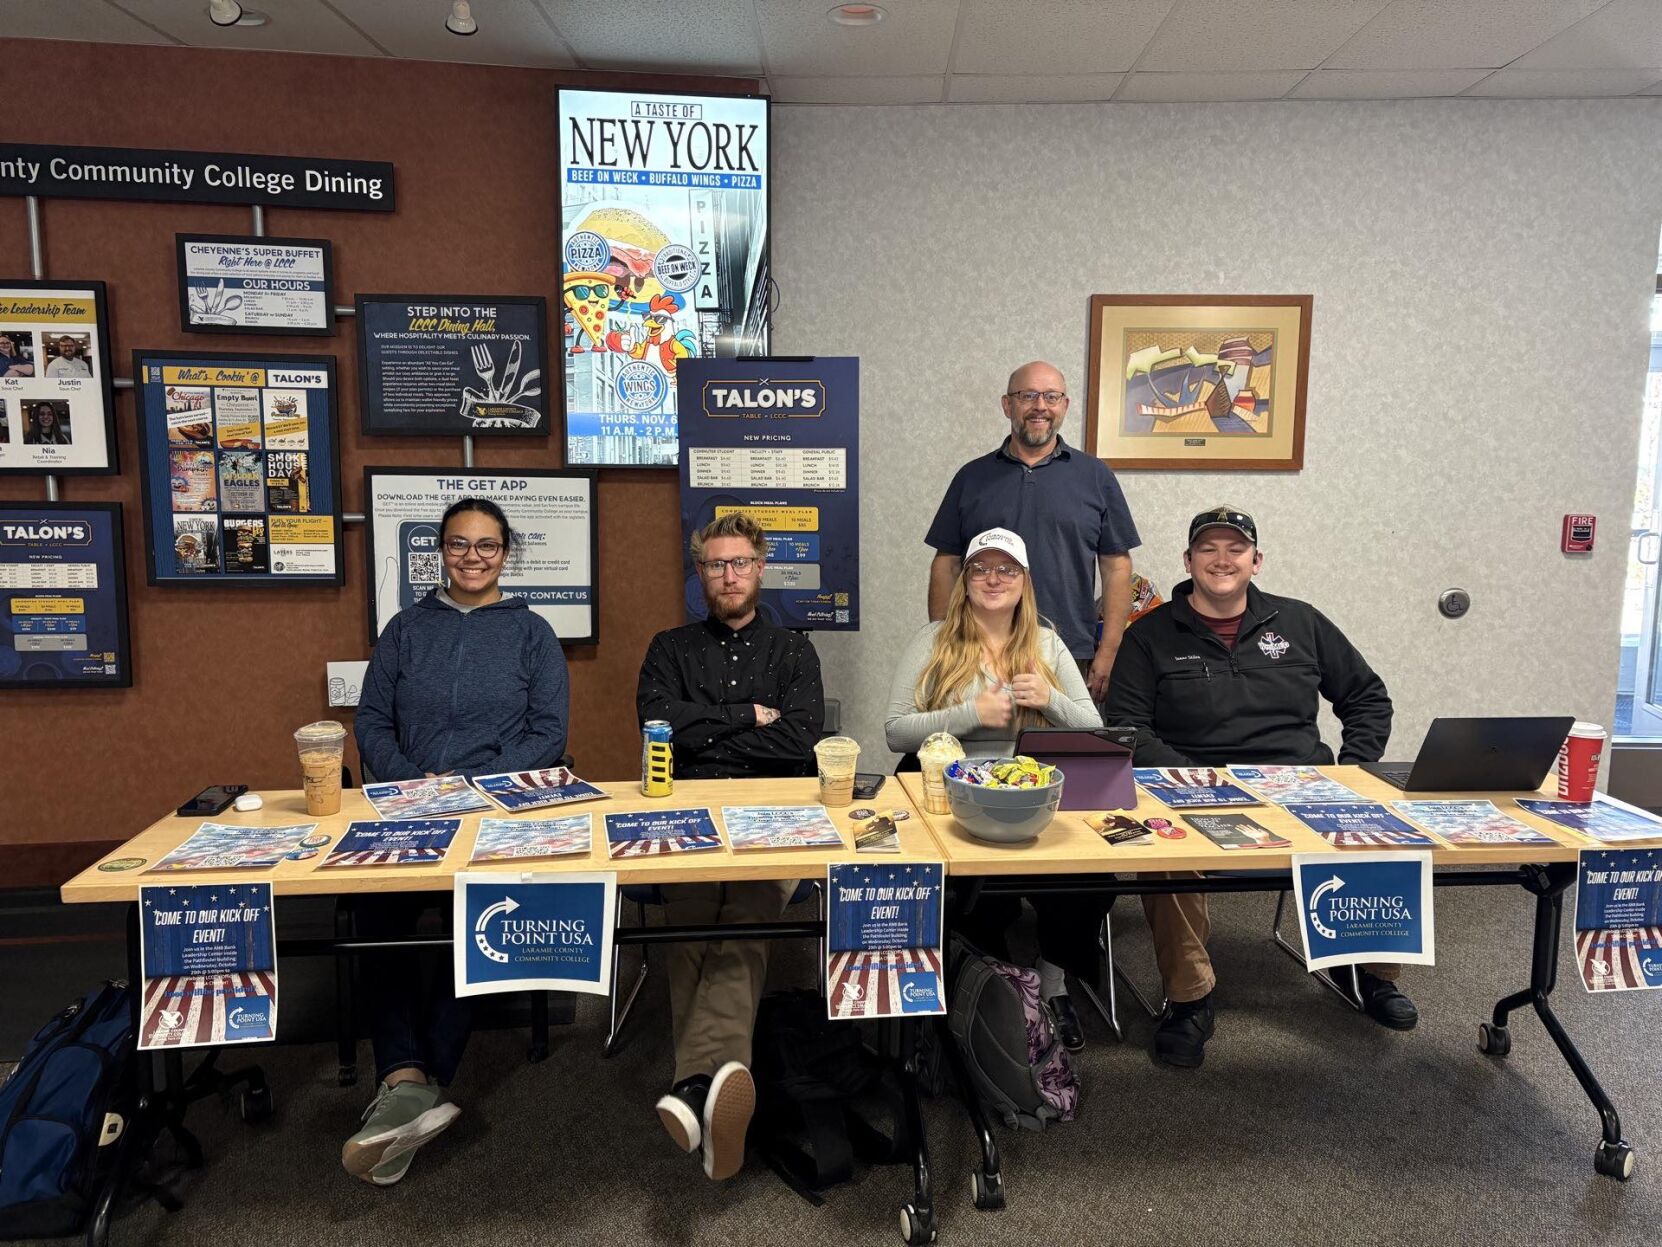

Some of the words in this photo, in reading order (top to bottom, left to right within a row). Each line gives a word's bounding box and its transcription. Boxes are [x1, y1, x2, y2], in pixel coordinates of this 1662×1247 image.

[634, 103, 641, 115] A
[646, 104, 679, 117] TASTE
[682, 105, 695, 118] OF
[569, 117, 655, 168] NEW
[664, 121, 759, 172] YORK
[50, 158, 194, 189] Community
[204, 164, 295, 194] College
[306, 170, 383, 199] Dining
[572, 170, 594, 182] BEEF
[598, 171, 610, 182] ON
[613, 172, 639, 184] WECK
[650, 174, 688, 186] BUFFALO
[692, 175, 721, 187] WINGS
[732, 176, 757, 188] PIZZA
[190, 246, 251, 256] CHEYENNE'S
[253, 249, 283, 258] SUPER
[286, 250, 321, 259] BUFFET
[571, 247, 602, 259] PIZZA
[218, 255, 243, 268] Right
[243, 257, 263, 268] Here
[274, 258, 296, 269] LCCC
[657, 265, 671, 275] BEEF
[672, 264, 679, 273] ON
[680, 262, 697, 272] WECK
[243, 279, 269, 289] OUR
[271, 280, 311, 291] HOURS
[10, 303, 61, 318] Leadership
[62, 304, 87, 315] Team
[407, 306, 437, 318] STEP
[440, 307, 471, 318] INTO
[474, 307, 497, 318] THE
[408, 318, 438, 332] LCCC
[438, 319, 470, 334] Dining
[398, 332, 443, 340] HOSPITALITY
[466, 333, 500, 341] CULINARY
[5, 378, 19, 386] Kat
[178, 369, 209, 381] What's
[216, 371, 250, 383] Cookin'
[250, 372, 260, 384] @
[273, 374, 322, 384] TALON'S
[624, 380, 656, 392] WINGS
[171, 391, 205, 402] Chicago
[216, 394, 239, 402] Empty
[712, 389, 817, 409] TALON'S
[599, 414, 640, 424] THURS.
[642, 415, 669, 425] NOV.
[671, 416, 678, 425] 6
[601, 426, 611, 435] 11
[613, 426, 638, 436] A.M.
[646, 427, 653, 436] 2
[655, 427, 678, 436] P.M.
[268, 454, 308, 462] SMOKE
[268, 461, 308, 470] HOUSE
[268, 470, 293, 478] DAY
[437, 480, 464, 490] THE
[468, 480, 496, 491] GET
[500, 480, 528, 491] APP
[177, 521, 194, 531] NEW
[194, 521, 215, 531] YORK
[224, 518, 265, 528] BURGERS
[1572, 516, 1594, 525] FIRE
[3, 526, 85, 540] TALON'S
[411, 536, 437, 547] GET
[530, 591, 575, 600] CONTACT
[576, 592, 588, 600] US
[1587, 870, 1609, 885] COME
[1610, 871, 1620, 884] TO
[1620, 870, 1635, 884] OUR
[1636, 870, 1653, 883] KICK
[840, 888, 863, 902] COME
[866, 888, 876, 901] TO
[877, 888, 894, 901] OUR
[896, 887, 915, 900] KICK
[916, 887, 932, 901] OFF
[1614, 888, 1640, 901] EVENT!
[1328, 896, 1403, 910] TURNING
[156, 910, 182, 926] COME
[185, 910, 197, 924] TO
[198, 910, 218, 924] OUR
[220, 908, 242, 923] KICK
[244, 908, 261, 922] OFF
[870, 906, 900, 920] EVENT!
[1330, 908, 1379, 922] POINT
[1382, 908, 1413, 920] USA
[501, 920, 585, 933] TURNING
[193, 928, 226, 944] EVENT!
[502, 932, 558, 946] POINT
[562, 932, 594, 946] USA
[1340, 930, 1380, 938] COMMUNITY
